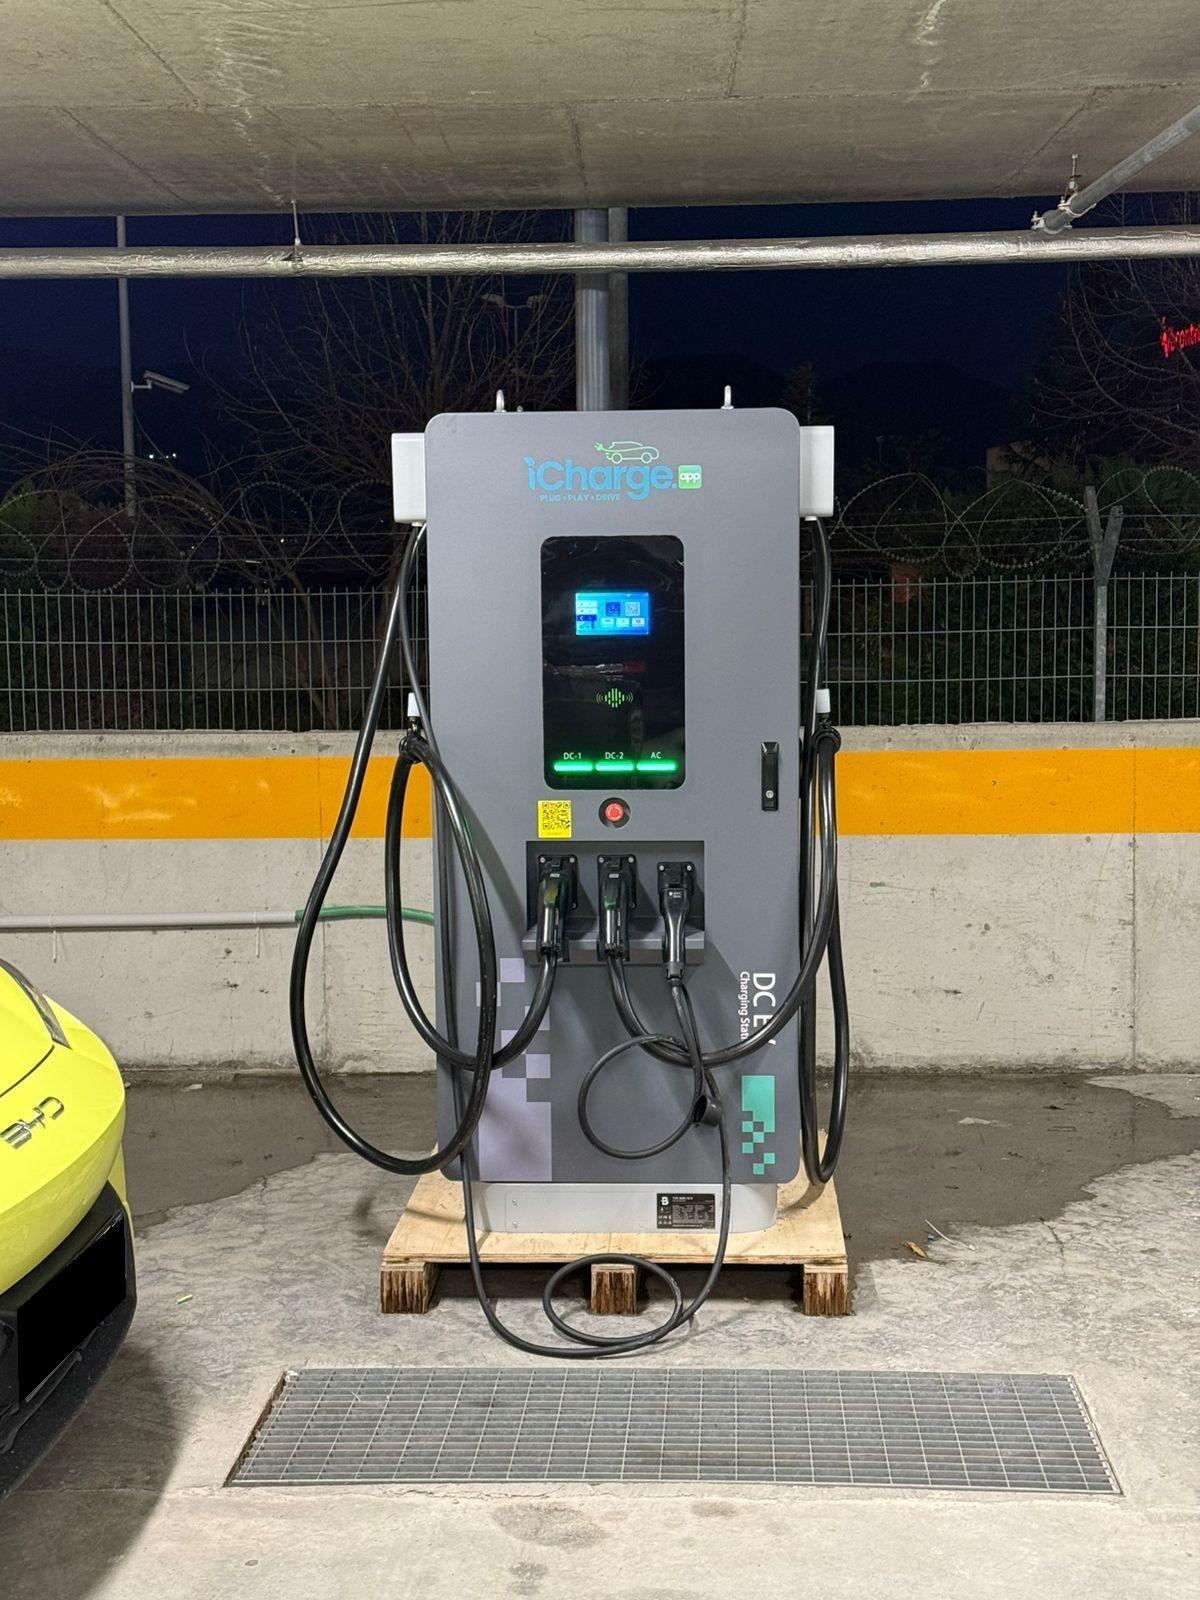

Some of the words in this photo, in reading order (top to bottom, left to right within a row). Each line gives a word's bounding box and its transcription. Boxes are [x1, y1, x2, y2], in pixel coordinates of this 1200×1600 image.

[540, 494, 561, 502] PLUG
[567, 494, 589, 502] PLAY
[595, 493, 620, 501] DRIVE
[563, 752, 582, 760] DC-1
[605, 752, 624, 760] DC-2
[650, 751, 662, 759] AC
[738, 971, 750, 1016] Charging
[753, 972, 776, 1007] DC
[740, 1017, 750, 1040] Stati
